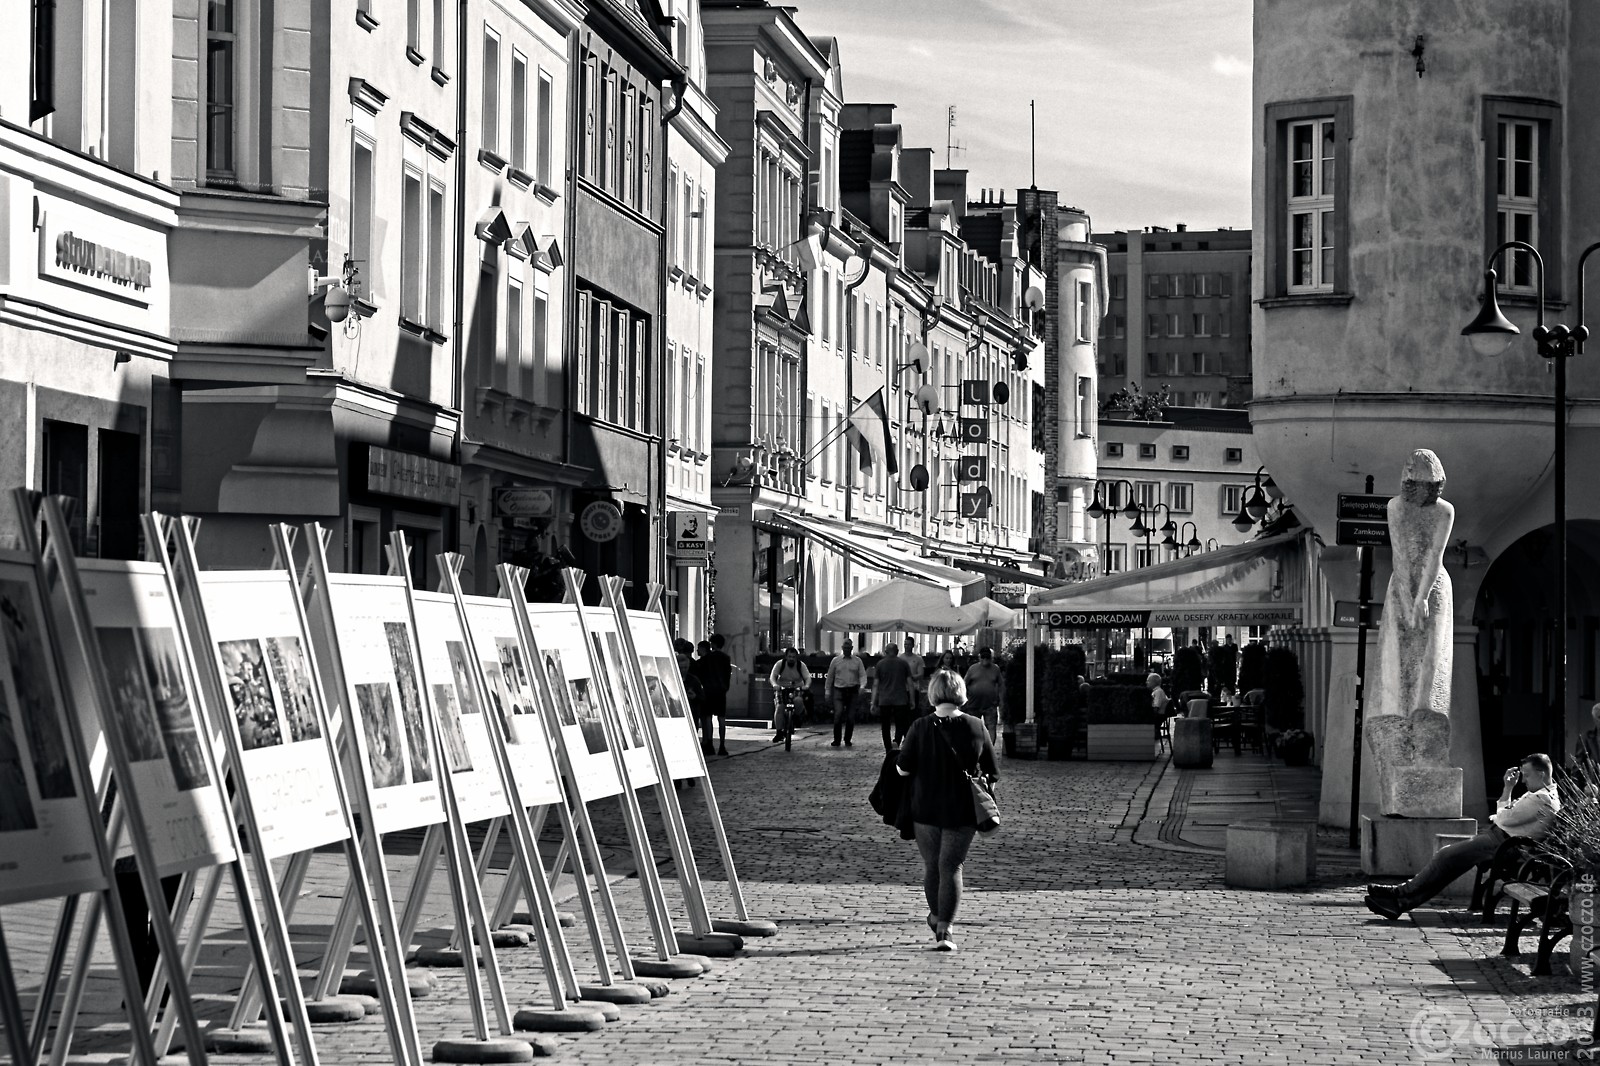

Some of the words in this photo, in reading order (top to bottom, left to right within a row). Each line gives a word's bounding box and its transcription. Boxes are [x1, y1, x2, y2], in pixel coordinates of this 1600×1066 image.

[1342, 500, 1369, 510] Świętego
[1353, 527, 1385, 536] Zamkowa
[1064, 615, 1087, 624] POD
[1088, 614, 1143, 624] ARKADAMI
[1155, 614, 1181, 622] KAWA
[1183, 613, 1215, 622] DESERY
[1217, 613, 1250, 621] KRAFTY
[1252, 612, 1293, 621] KOKTAJLE
